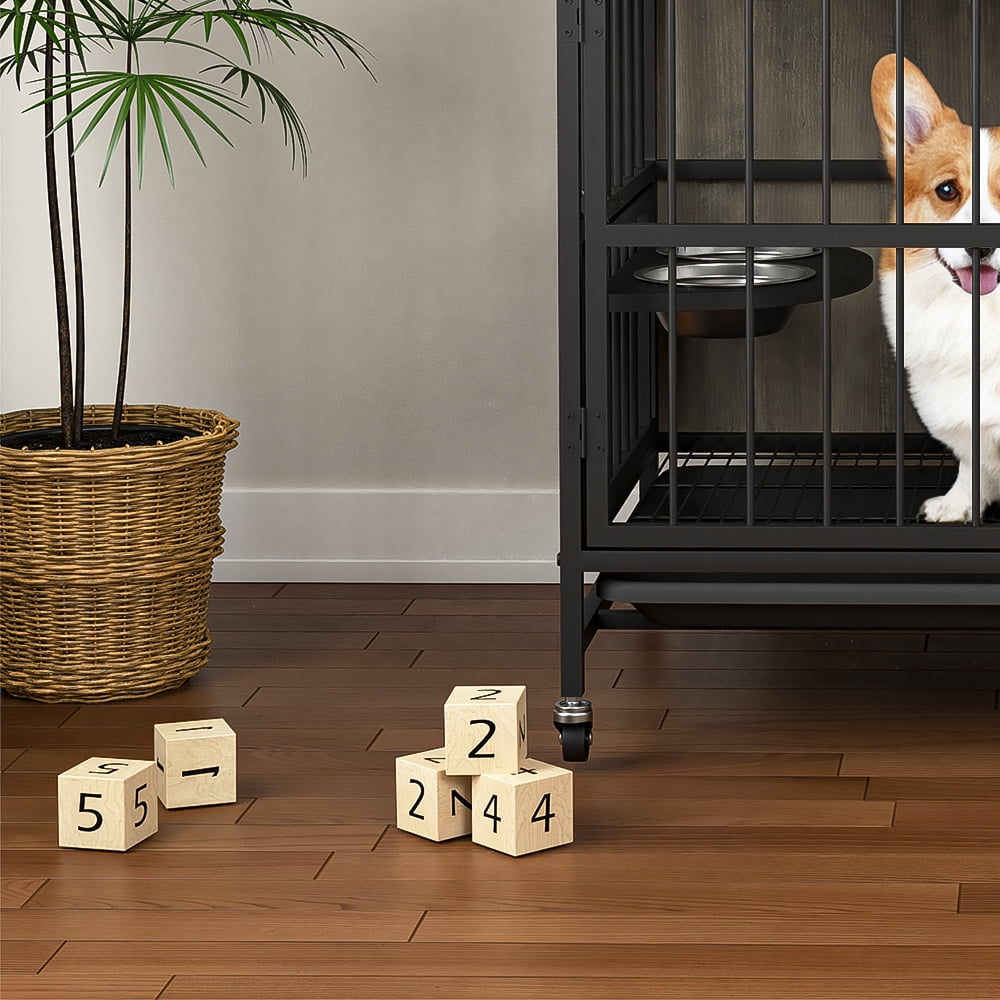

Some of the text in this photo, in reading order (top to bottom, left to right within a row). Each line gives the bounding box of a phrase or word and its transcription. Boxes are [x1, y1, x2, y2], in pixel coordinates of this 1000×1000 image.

[467, 719, 497, 759] 2
[181, 766, 221, 778] 1
[77, 792, 104, 833] 5
[134, 783, 148, 828] 5
[408, 778, 425, 821] 2
[482, 793, 502, 834] 4
[530, 792, 556, 833] 4
